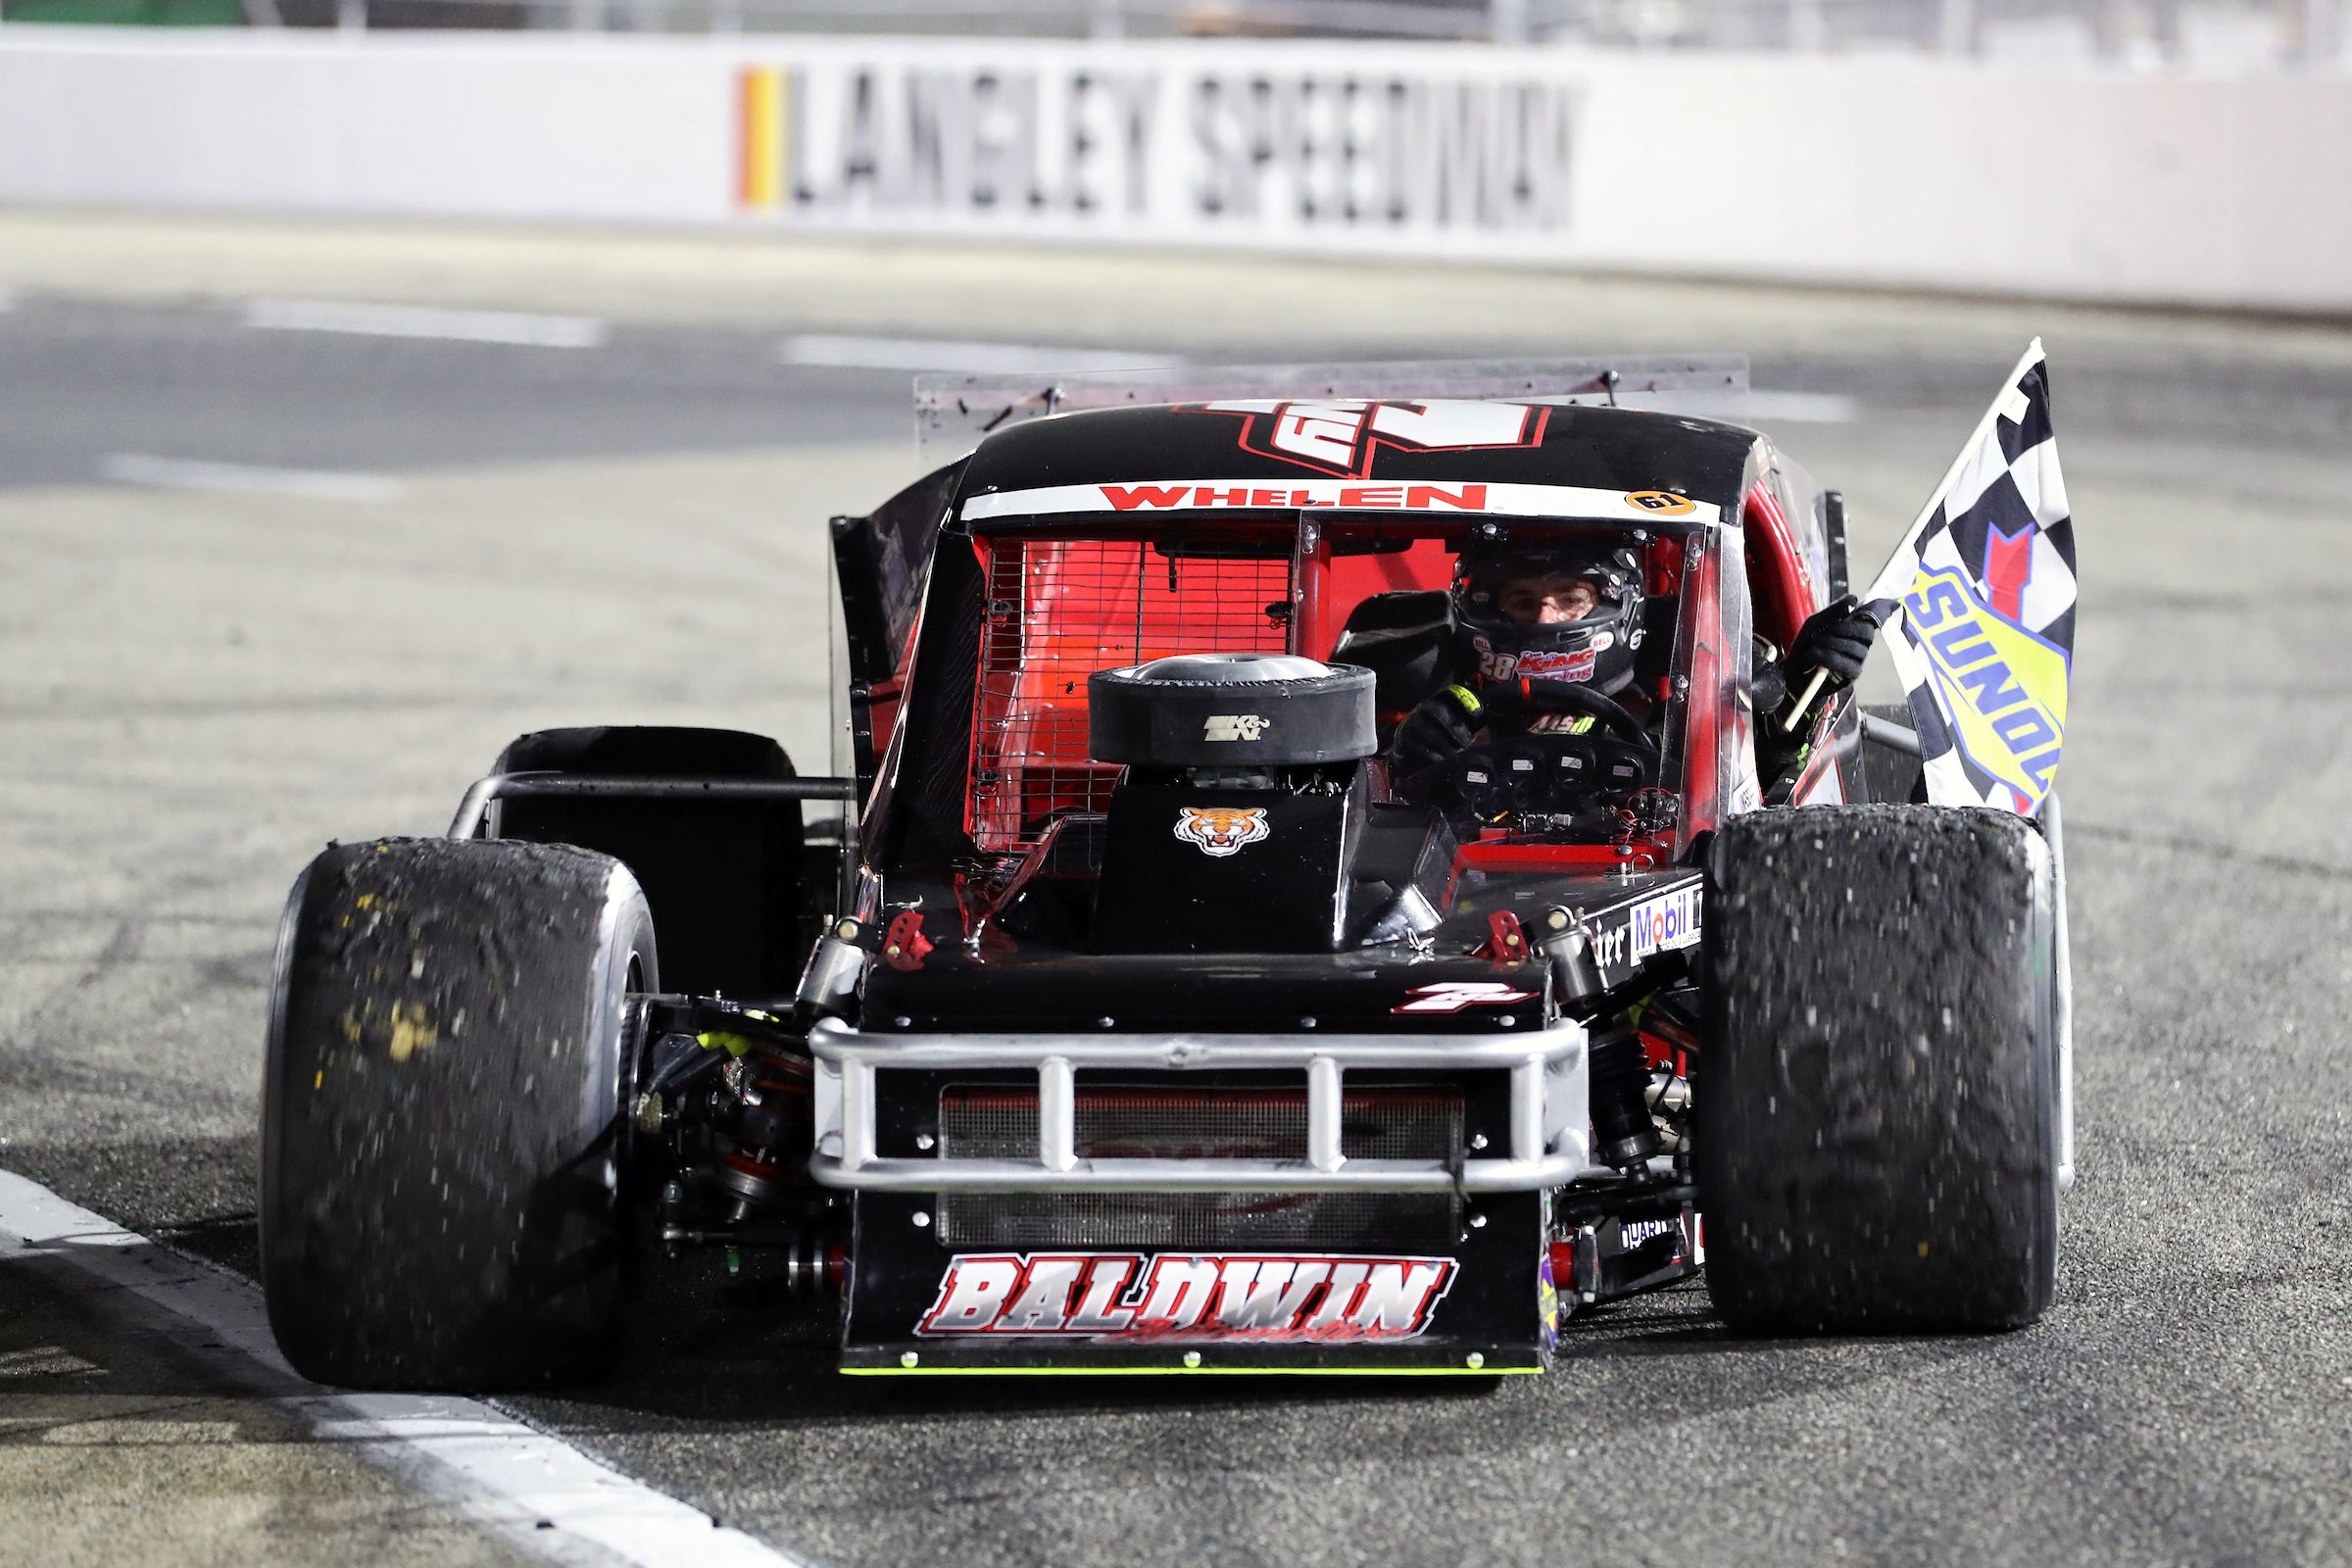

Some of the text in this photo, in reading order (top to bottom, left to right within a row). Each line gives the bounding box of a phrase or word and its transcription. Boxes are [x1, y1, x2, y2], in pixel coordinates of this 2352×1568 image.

[787, 69, 1582, 227] LANGLEY SPEEDWAY
[1099, 484, 1487, 511] WHELEN
[1640, 494, 1684, 512] 61
[1593, 637, 1611, 648] BELL
[1480, 651, 1518, 680] 28
[1203, 714, 1271, 742] K&N
[1636, 892, 1687, 952] Mobil
[921, 1255, 1452, 1334] BALDWIN
